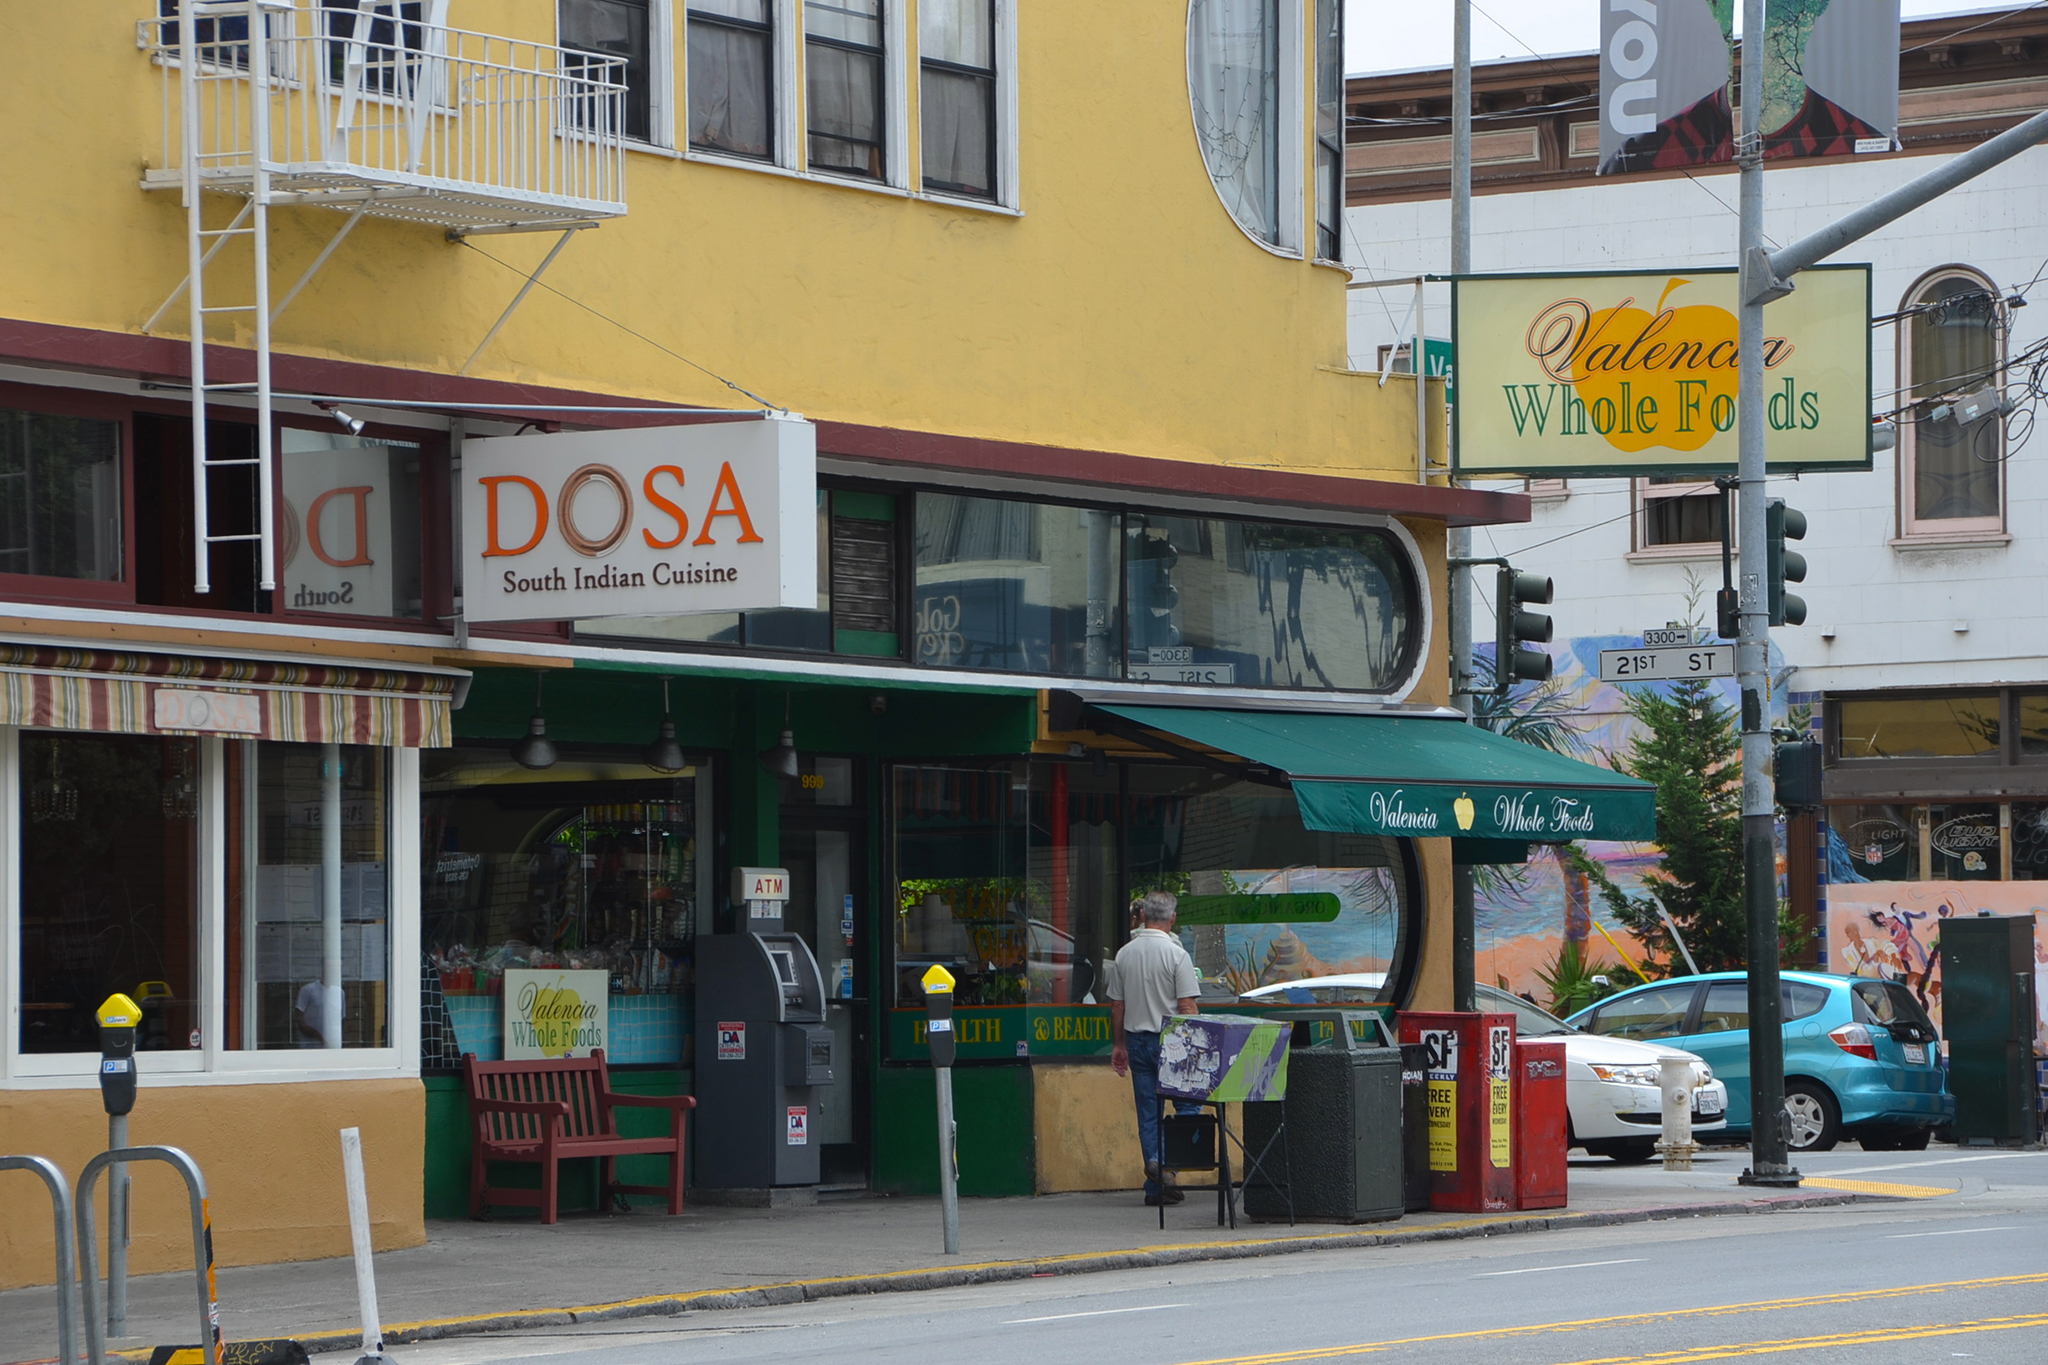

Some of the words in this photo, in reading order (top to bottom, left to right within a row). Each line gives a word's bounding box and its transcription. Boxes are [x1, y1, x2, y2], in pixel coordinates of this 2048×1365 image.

[1501, 382, 1658, 437] Whole
[1674, 377, 1819, 432] Fods
[478, 461, 763, 558] DOSA
[503, 567, 567, 593] South
[574, 564, 646, 590] Indian
[652, 562, 738, 586] Cuisine
[1645, 631, 1676, 644] 3300
[1617, 656, 1657, 674] 21ST
[1688, 653, 1716, 671] ST
[161, 692, 254, 729] DOSA
[801, 774, 824, 788] 999
[1370, 789, 1438, 829] Valencia
[1494, 791, 1545, 832] Whole
[1550, 796, 1594, 832] Foods
[1871, 829, 1907, 840] LIGHT
[1949, 825, 1997, 837] BUD
[1938, 835, 2000, 847] LIGHT
[754, 878, 783, 894] ATM
[517, 982, 599, 1025] Valencia
[511, 1021, 557, 1048] Whole
[561, 1021, 602, 1048] Foods
[913, 1018, 1002, 1044] HLTH
[1053, 1016, 1111, 1041] BEAUTY
[1319, 1020, 1365, 1038] PANI
[1425, 1033, 1455, 1069] SF
[1402, 1070, 1423, 1081] RDIAN
[1493, 1086, 1507, 1099] FREE
[1429, 1106, 1451, 1118] VERY
[1429, 1120, 1451, 1128] DNESDAY
